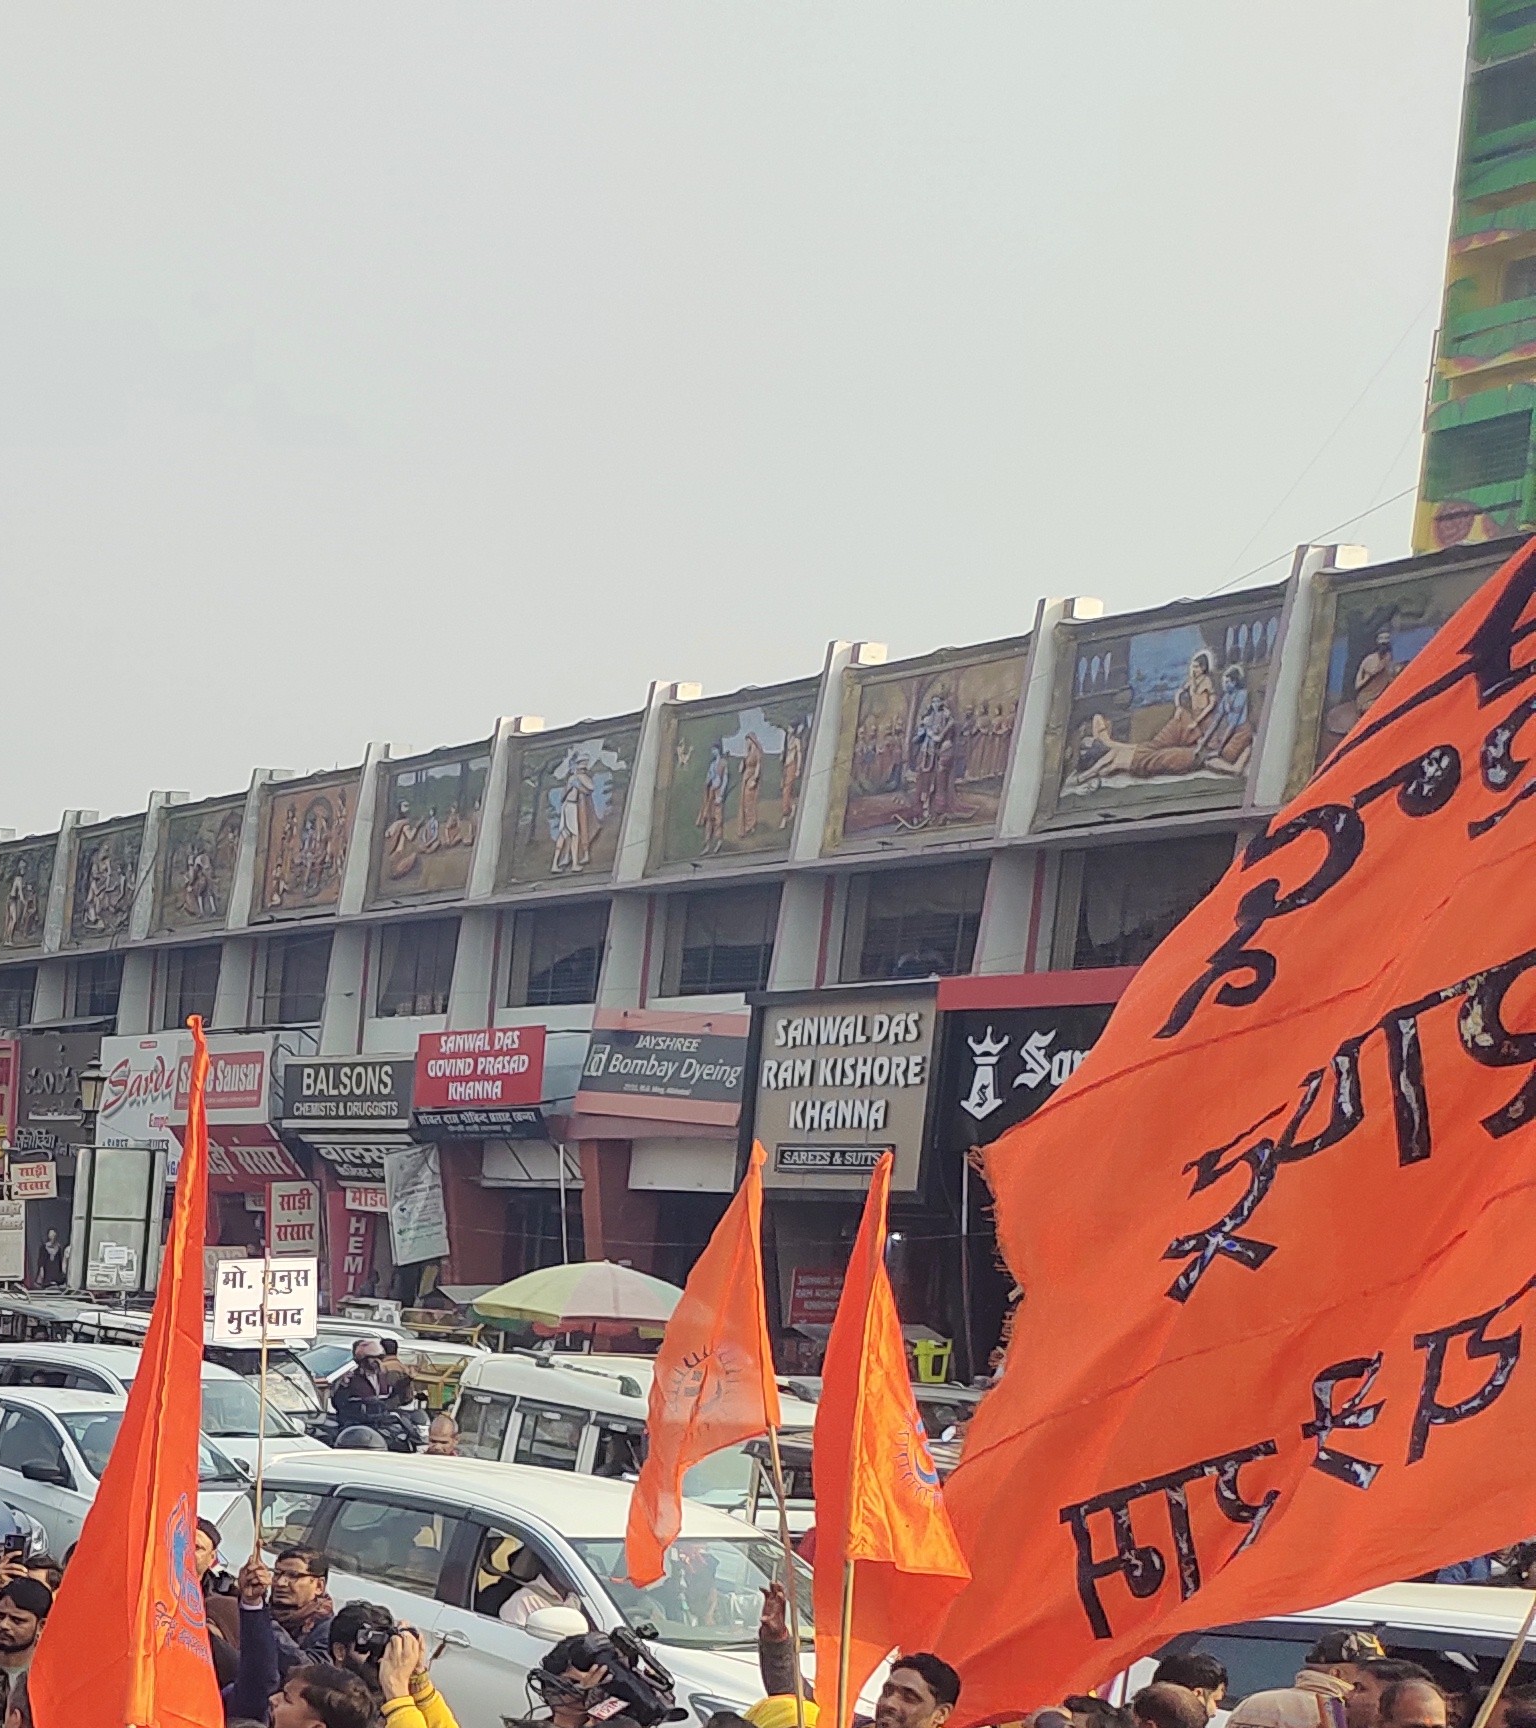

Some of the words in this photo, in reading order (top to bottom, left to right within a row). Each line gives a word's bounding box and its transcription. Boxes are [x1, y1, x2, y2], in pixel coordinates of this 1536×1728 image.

[439, 1032, 490, 1054] SANWAL
[494, 1030, 520, 1051] DAS
[774, 1014, 867, 1048] SANWAL
[872, 1012, 921, 1045] DAS
[634, 1034, 701, 1052] JAYSHREE
[215, 1059, 261, 1093] Sansar
[427, 1057, 474, 1078] GOVIND
[477, 1054, 529, 1077] PRASAD
[608, 1053, 678, 1083] Bombay
[679, 1058, 742, 1088] Dyeing
[761, 1058, 813, 1090] RAM
[818, 1055, 926, 1088] KISHORE
[302, 1065, 393, 1096] BALSONS
[448, 1080, 502, 1101] KHANNA
[293, 1102, 337, 1116] CHEMISTS
[347, 1101, 399, 1116] DRUGGISTS
[789, 1099, 888, 1131] KHANNA
[782, 1151, 831, 1165] SAREES
[832, 1151, 843, 1164] &
[843, 1151, 882, 1165] SUITS
[278, 1188, 313, 1216] साड़ी
[275, 1218, 315, 1241] संसार
[222, 1265, 253, 1290] मो.
